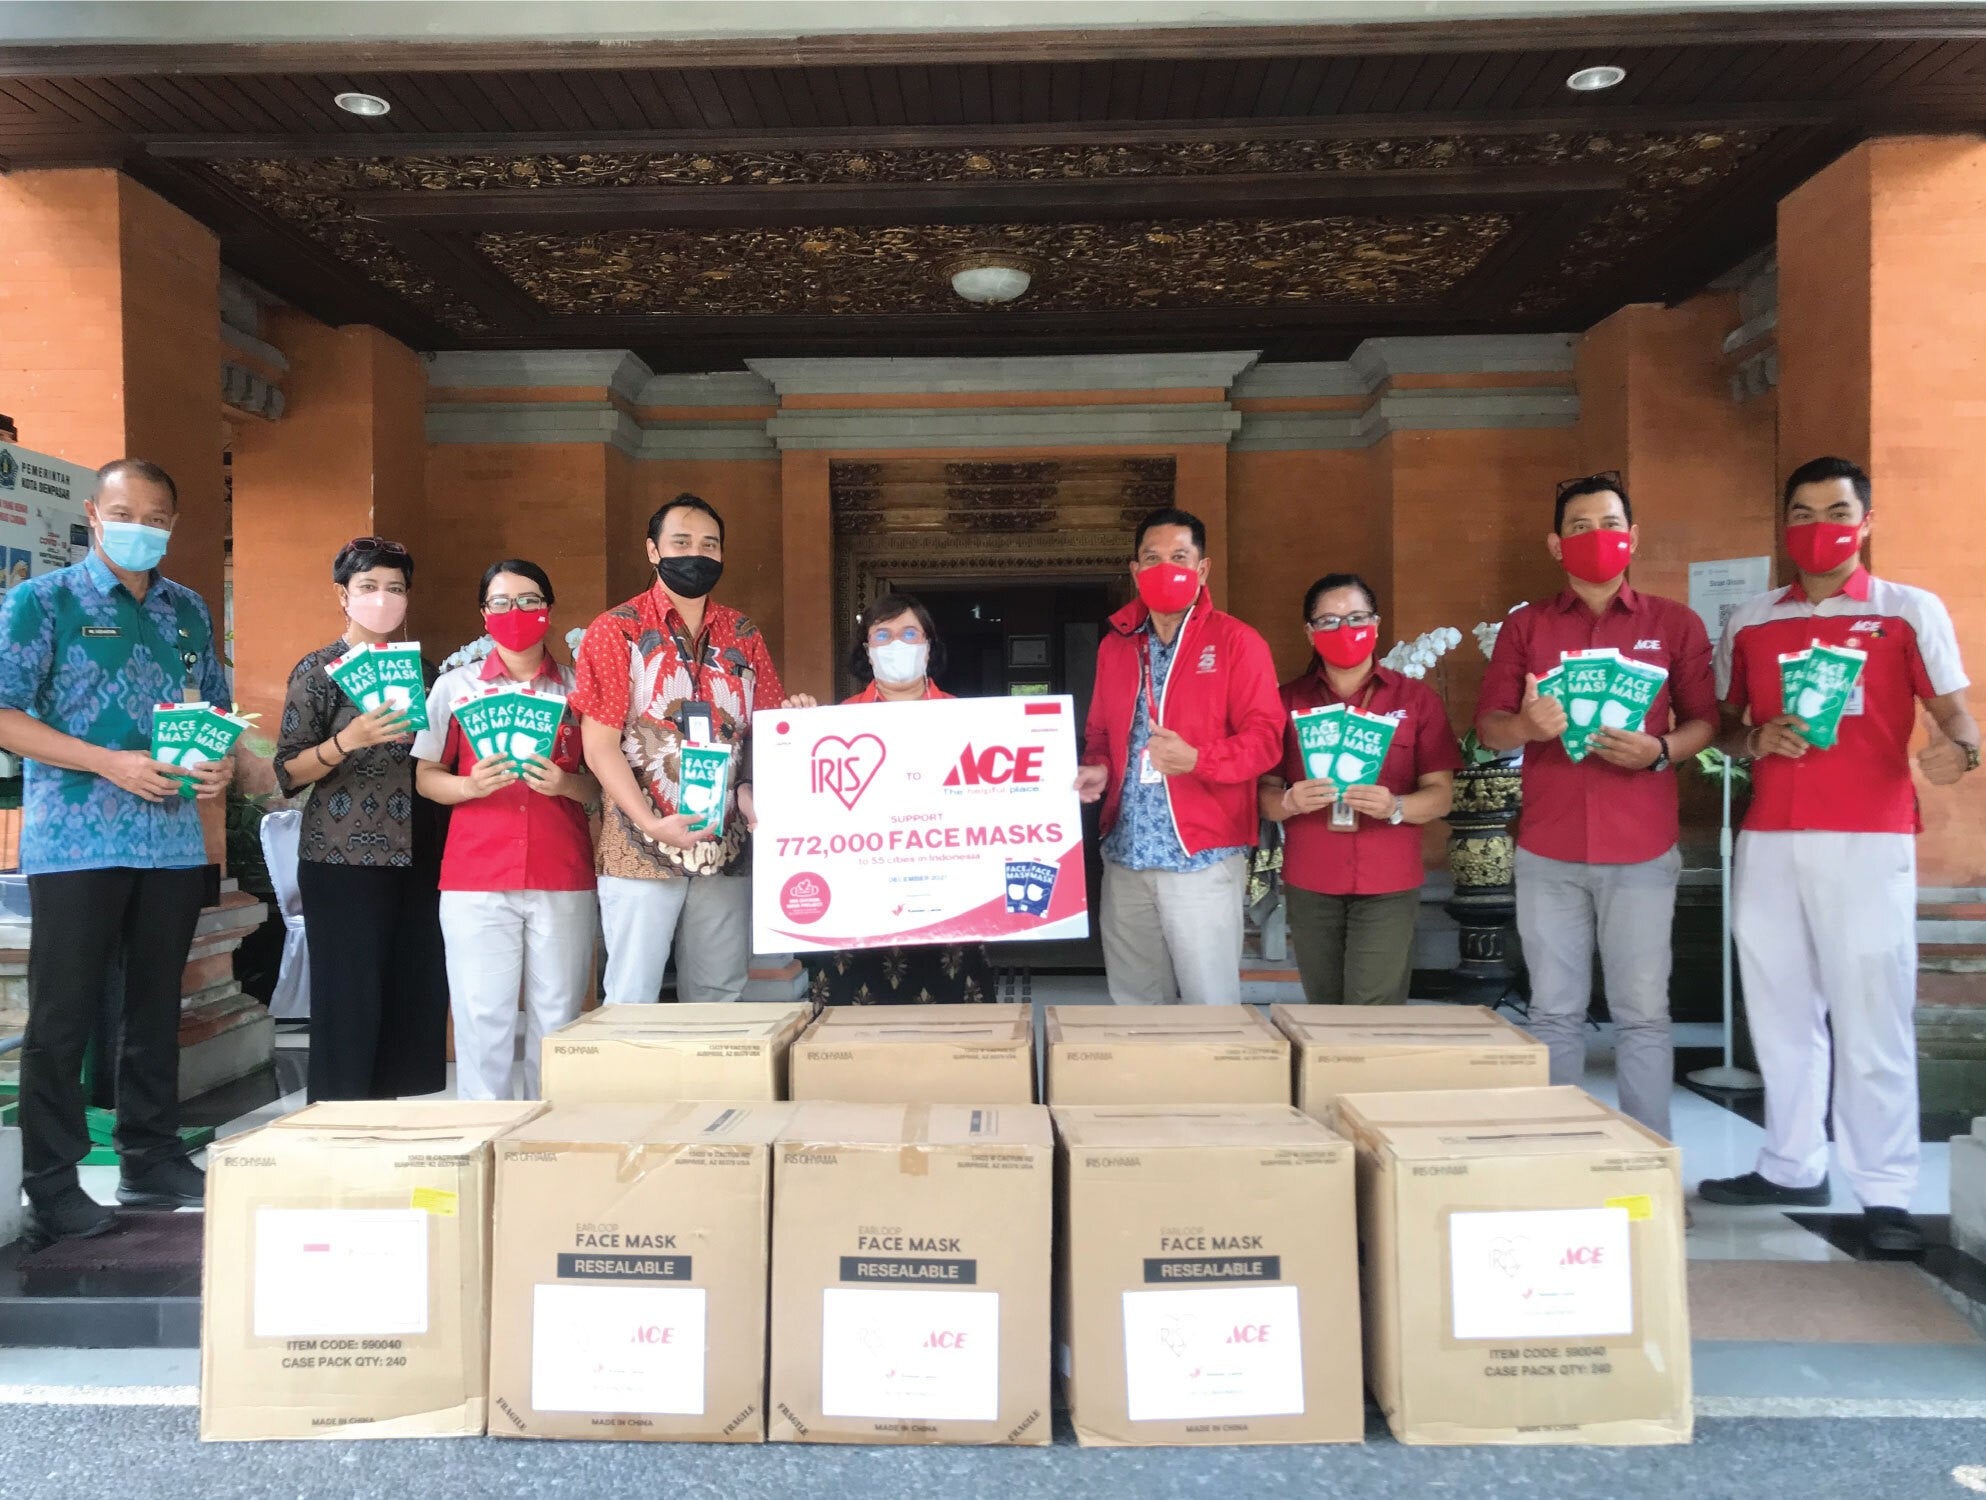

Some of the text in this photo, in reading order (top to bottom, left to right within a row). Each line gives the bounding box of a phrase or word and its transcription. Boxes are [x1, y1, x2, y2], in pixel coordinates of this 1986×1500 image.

[22, 462, 70, 485] PEMERINTAH
[22, 478, 70, 500] KOTA DENPASAR
[1849, 620, 1882, 631] ACE
[1633, 639, 1662, 650] ACE
[378, 659, 412, 670] FACE
[1810, 659, 1848, 677] FACE
[342, 662, 374, 686] FACE
[380, 670, 419, 682] MASK
[1568, 669, 1606, 681] FACE
[1784, 670, 1806, 683] FA
[350, 672, 377, 696] MAS
[1615, 673, 1653, 693] FACE
[1609, 684, 1653, 705] MASK
[489, 704, 515, 719] FAC
[517, 706, 553, 723] FACE
[159, 720, 197, 732] FACE
[467, 722, 488, 737] MA
[491, 716, 512, 729] MA
[514, 719, 553, 734] MASK
[1302, 721, 1341, 738] FACE
[158, 730, 194, 742] MAS
[200, 722, 234, 744] FACE
[1346, 726, 1383, 744] FACE
[194, 732, 228, 754] MASK
[1342, 737, 1384, 757] MASK
[685, 757, 720, 771] FACE
[811, 741, 1045, 794] IRIS TO ACE
[684, 769, 716, 782] MAS
[943, 787, 964, 797] The
[890, 813, 944, 824] SUPPORT
[776, 823, 1063, 858] 772,000 FACE MASKS
[871, 855, 885, 865] 55
[926, 852, 981, 862] Indonesia
[575, 1233, 677, 1249] FACE MASK
[857, 1236, 961, 1253] FACE MASK
[1160, 1235, 1263, 1252] FACE MASK
[1559, 1246, 1605, 1266] ACE
[574, 1259, 675, 1276] RESEALABLE
[857, 1262, 959, 1280] RESEALABLE
[1161, 1261, 1263, 1278] RESEALABLE
[631, 1325, 675, 1344] ACE
[923, 1330, 969, 1349] ACE
[1225, 1324, 1272, 1344] ACE
[286, 1340, 317, 1351] ITEM
[320, 1339, 359, 1350] CODE:
[1489, 1348, 1520, 1359] ITEM
[1522, 1347, 1561, 1359] CODE:
[282, 1356, 407, 1369] CASE PACK QTY: 240
[1484, 1365, 1519, 1377] CASE
[1521, 1364, 1556, 1377] PACK
[1559, 1364, 1588, 1377] QTY:
[311, 1417, 338, 1427] MADE
[495, 1395, 528, 1433] FRAGILE
[591, 1417, 616, 1427] MADE
[627, 1418, 654, 1428] CHINA
[722, 1403, 756, 1436] FRAGILE
[777, 1402, 810, 1437] FRAGILE
[1007, 1408, 1042, 1442] FRAGILE
[1185, 1423, 1211, 1433] MADE
[1222, 1422, 1248, 1432] CHINA
